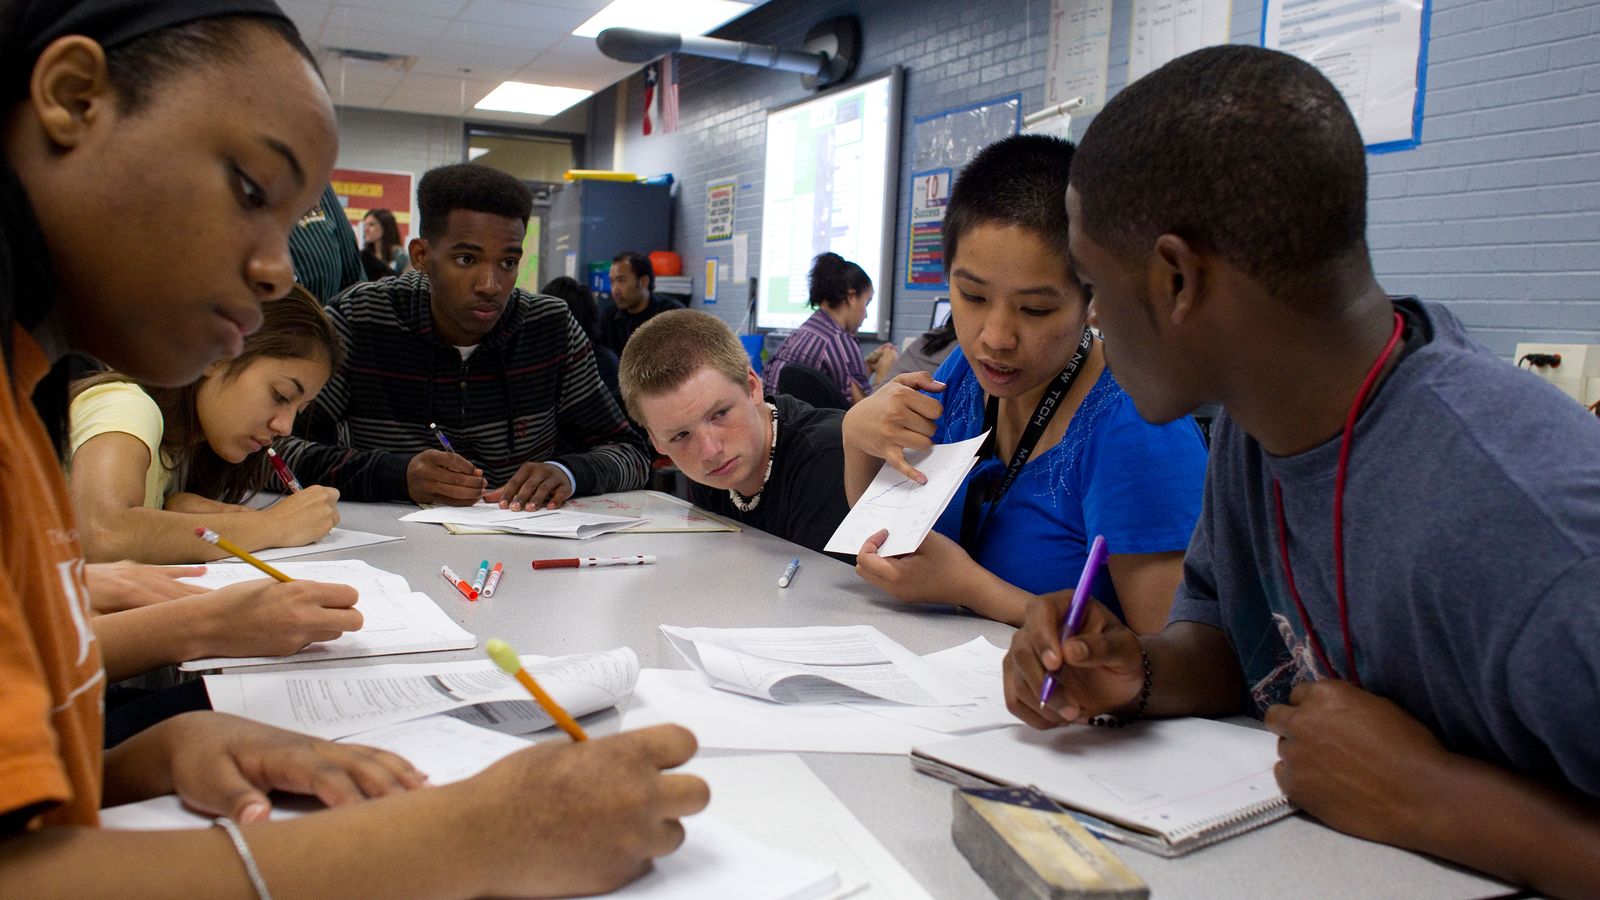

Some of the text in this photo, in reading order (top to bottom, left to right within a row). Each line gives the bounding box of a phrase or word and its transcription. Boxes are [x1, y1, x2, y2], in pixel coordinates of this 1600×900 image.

[926, 175, 939, 199] 10
[914, 207, 940, 218] Success
[1061, 352, 1083, 384] NEW
[1034, 390, 1062, 427] TECH
